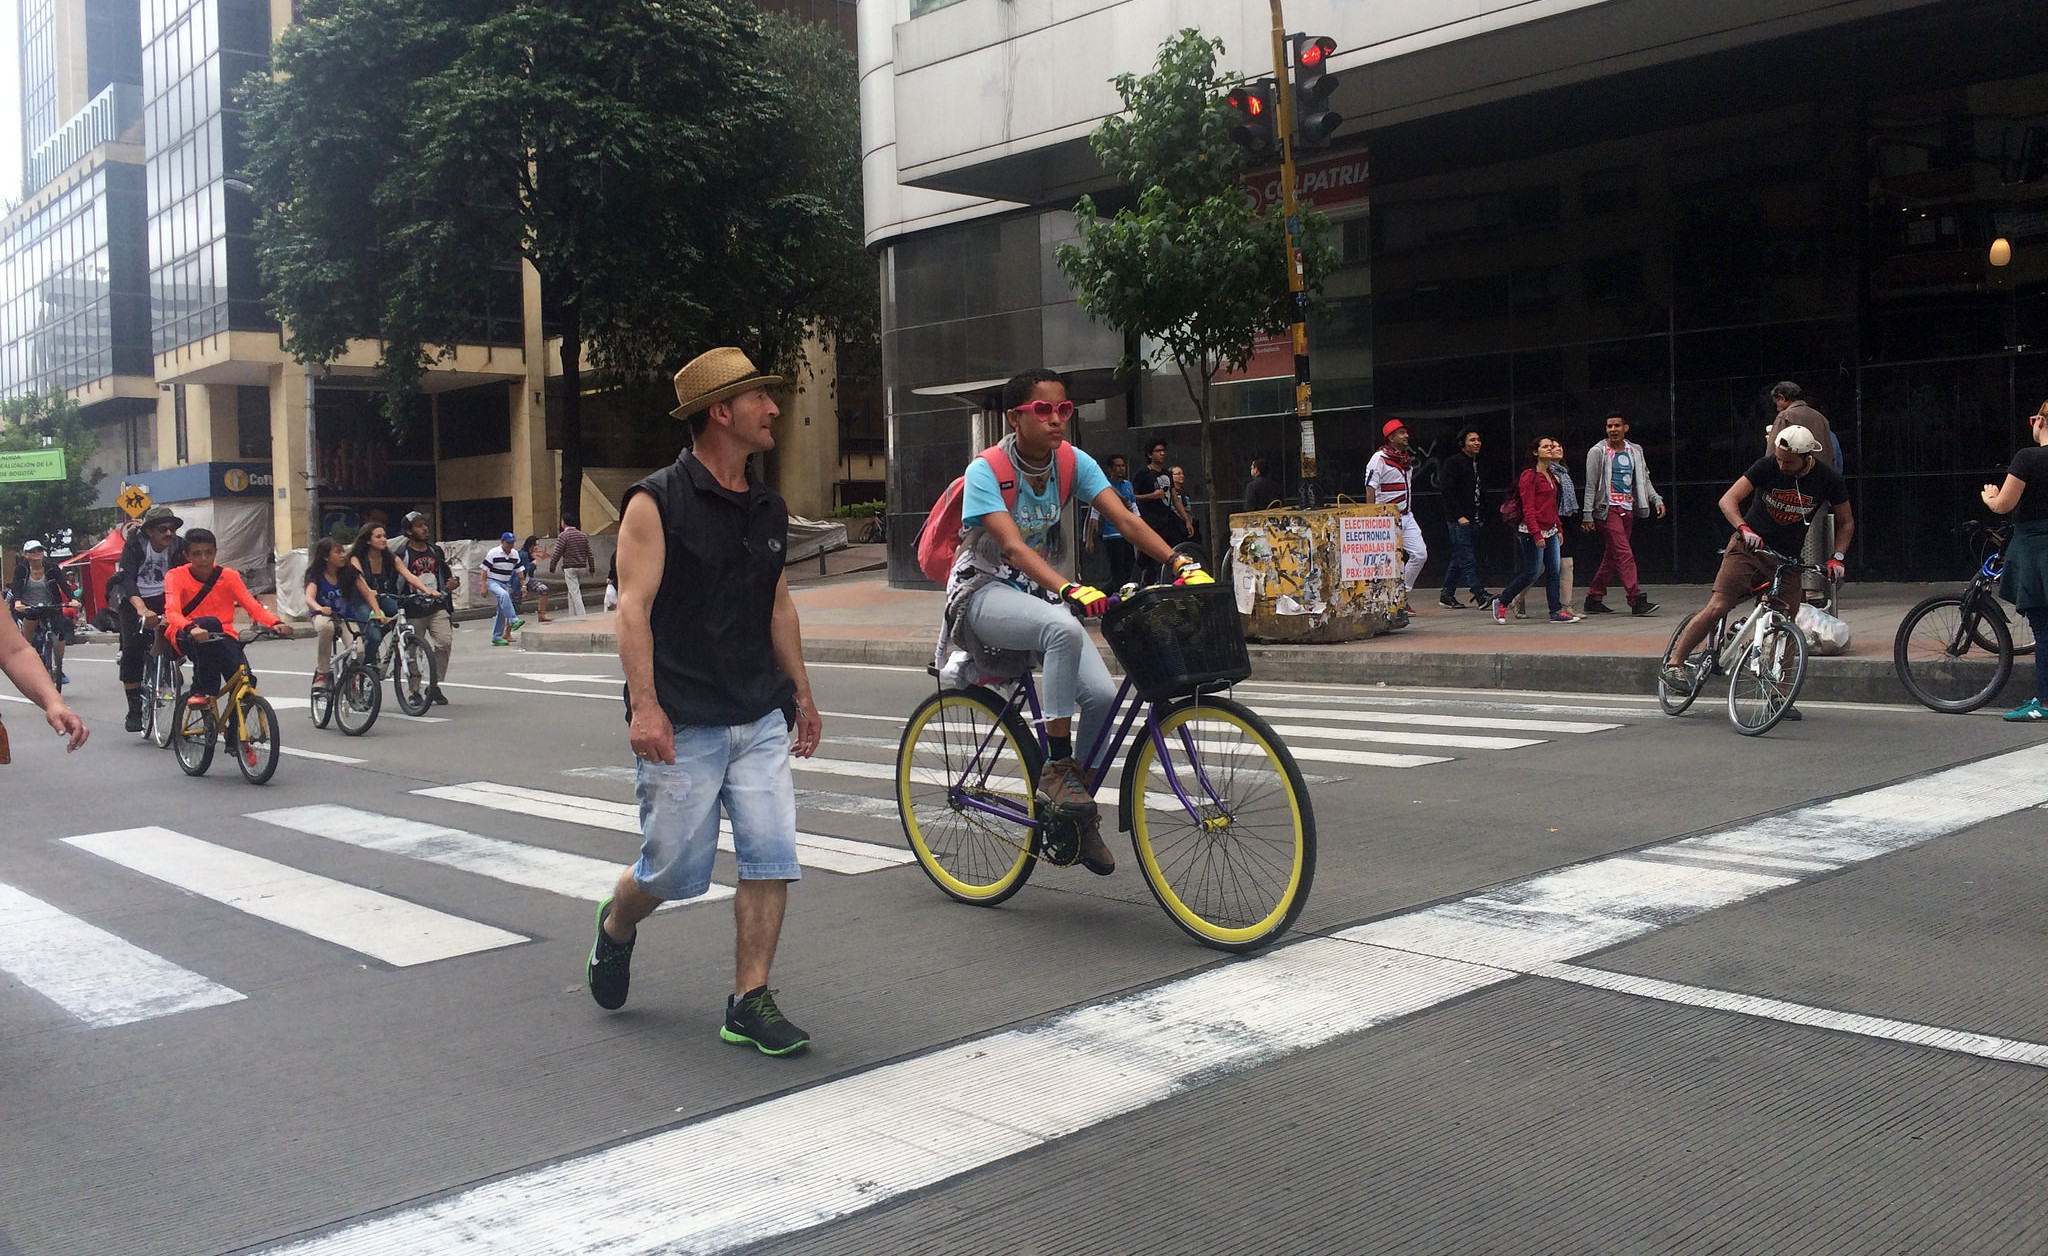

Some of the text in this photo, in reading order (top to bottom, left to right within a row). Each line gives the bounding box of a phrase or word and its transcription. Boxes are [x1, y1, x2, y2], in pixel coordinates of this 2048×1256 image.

[1344, 519, 1391, 529] ELECTRICIDAD
[1346, 531, 1391, 541] ELECTRONICA
[1342, 542, 1395, 554] APRENDALAS EN
[1346, 567, 1361, 578] PBX:
